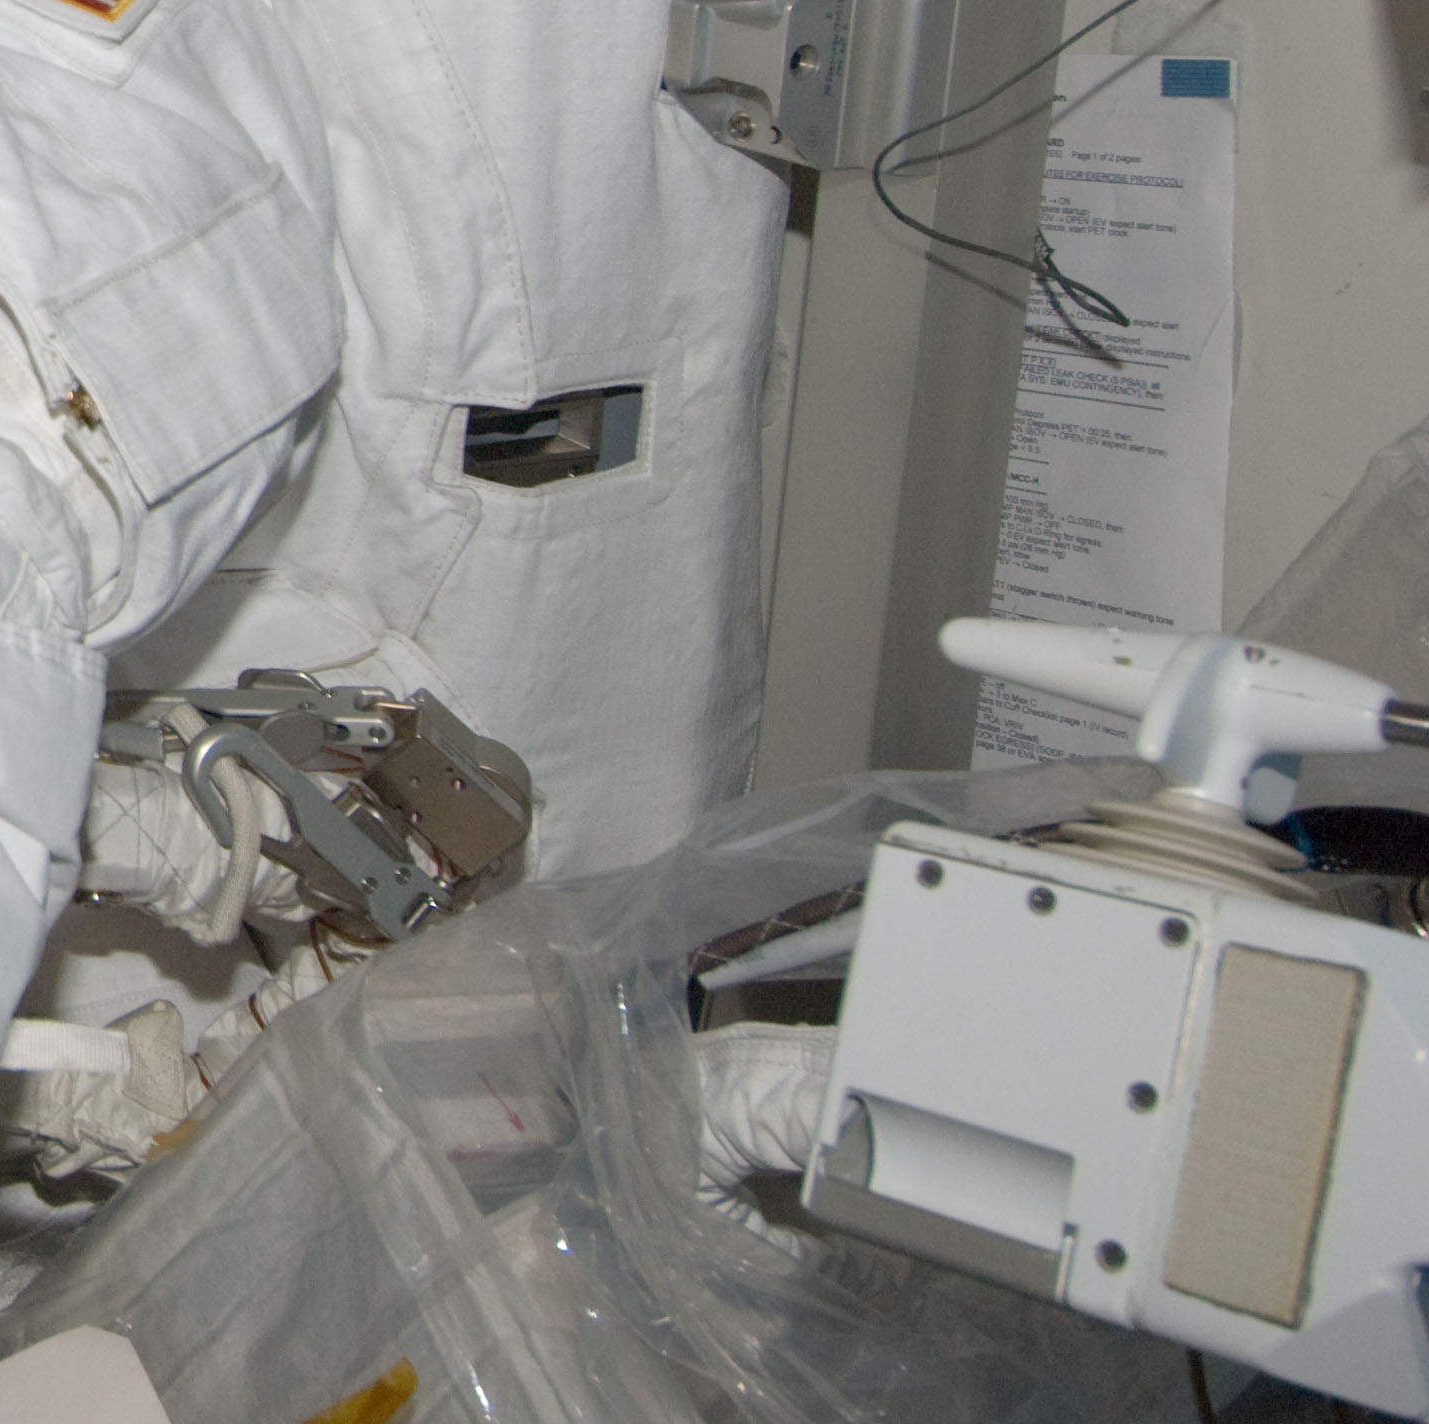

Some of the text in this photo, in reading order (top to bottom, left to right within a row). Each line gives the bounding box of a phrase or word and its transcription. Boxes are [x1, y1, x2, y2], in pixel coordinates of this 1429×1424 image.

[1071, 151, 1090, 161] Page
[1116, 156, 1141, 164] pages
[1085, 172, 1128, 182] EXERCISE
[1065, 216, 1089, 225] OPEN
[1052, 368, 1075, 378] LEAK
[1077, 371, 1108, 382] CHECK
[1060, 432, 1084, 443] OPEN
